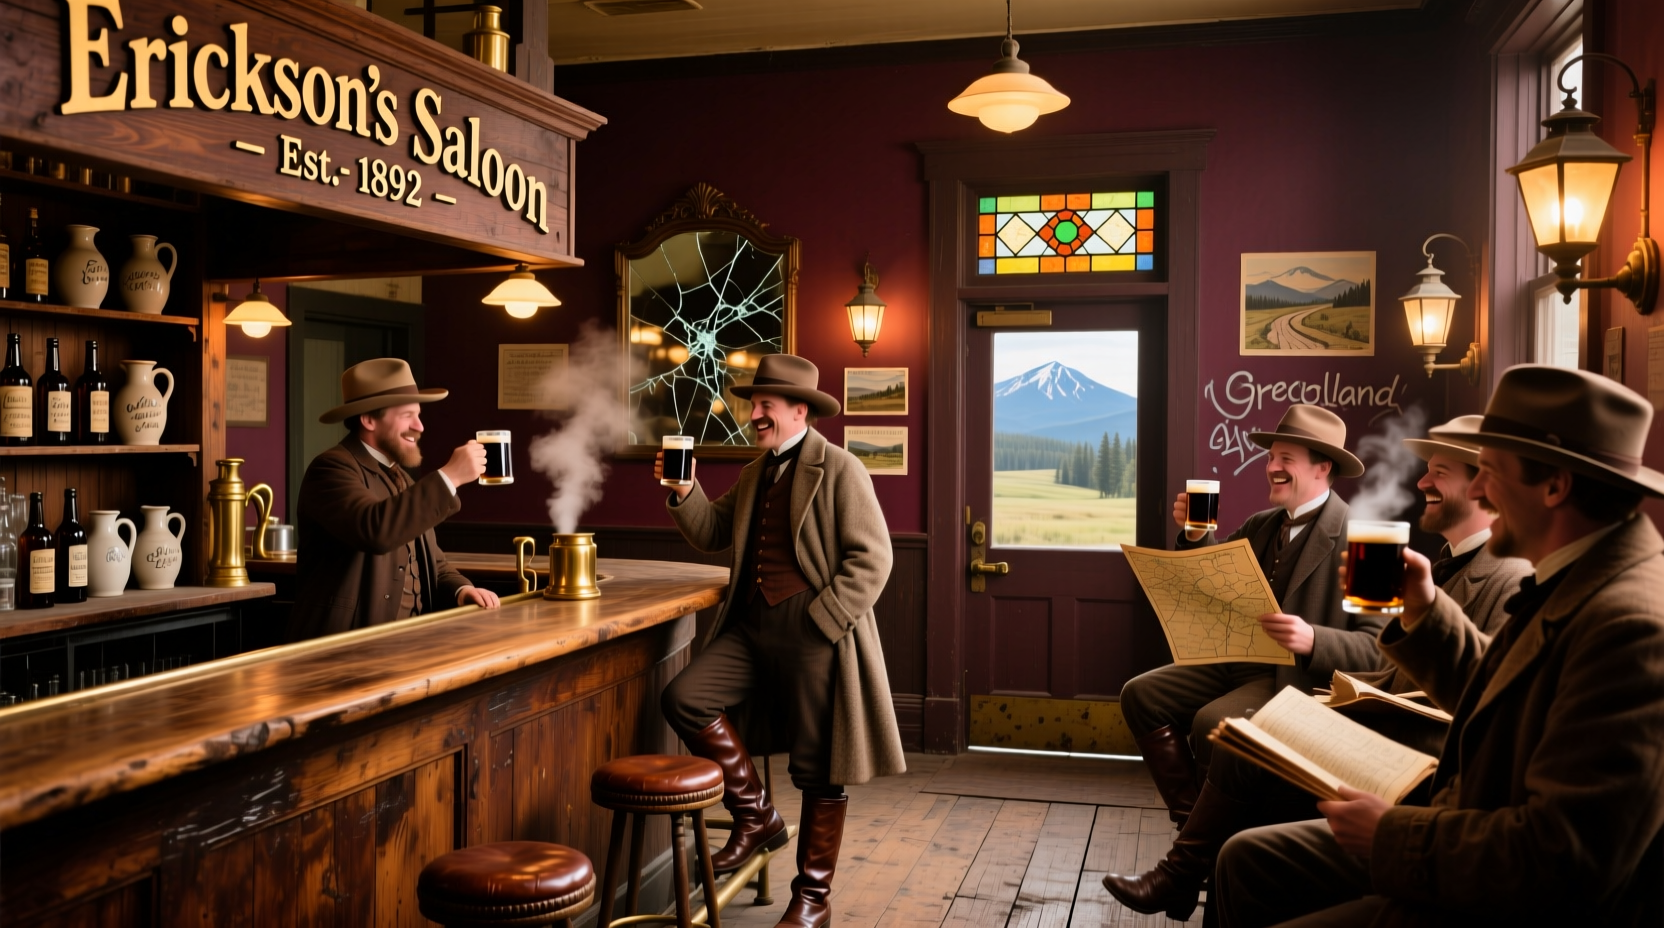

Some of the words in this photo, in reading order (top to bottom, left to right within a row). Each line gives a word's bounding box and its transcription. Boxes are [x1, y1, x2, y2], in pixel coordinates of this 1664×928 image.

[61, 0, 400, 146] Erickson's
[413, 87, 550, 234] Saloon
[357, 156, 423, 207] 1892
